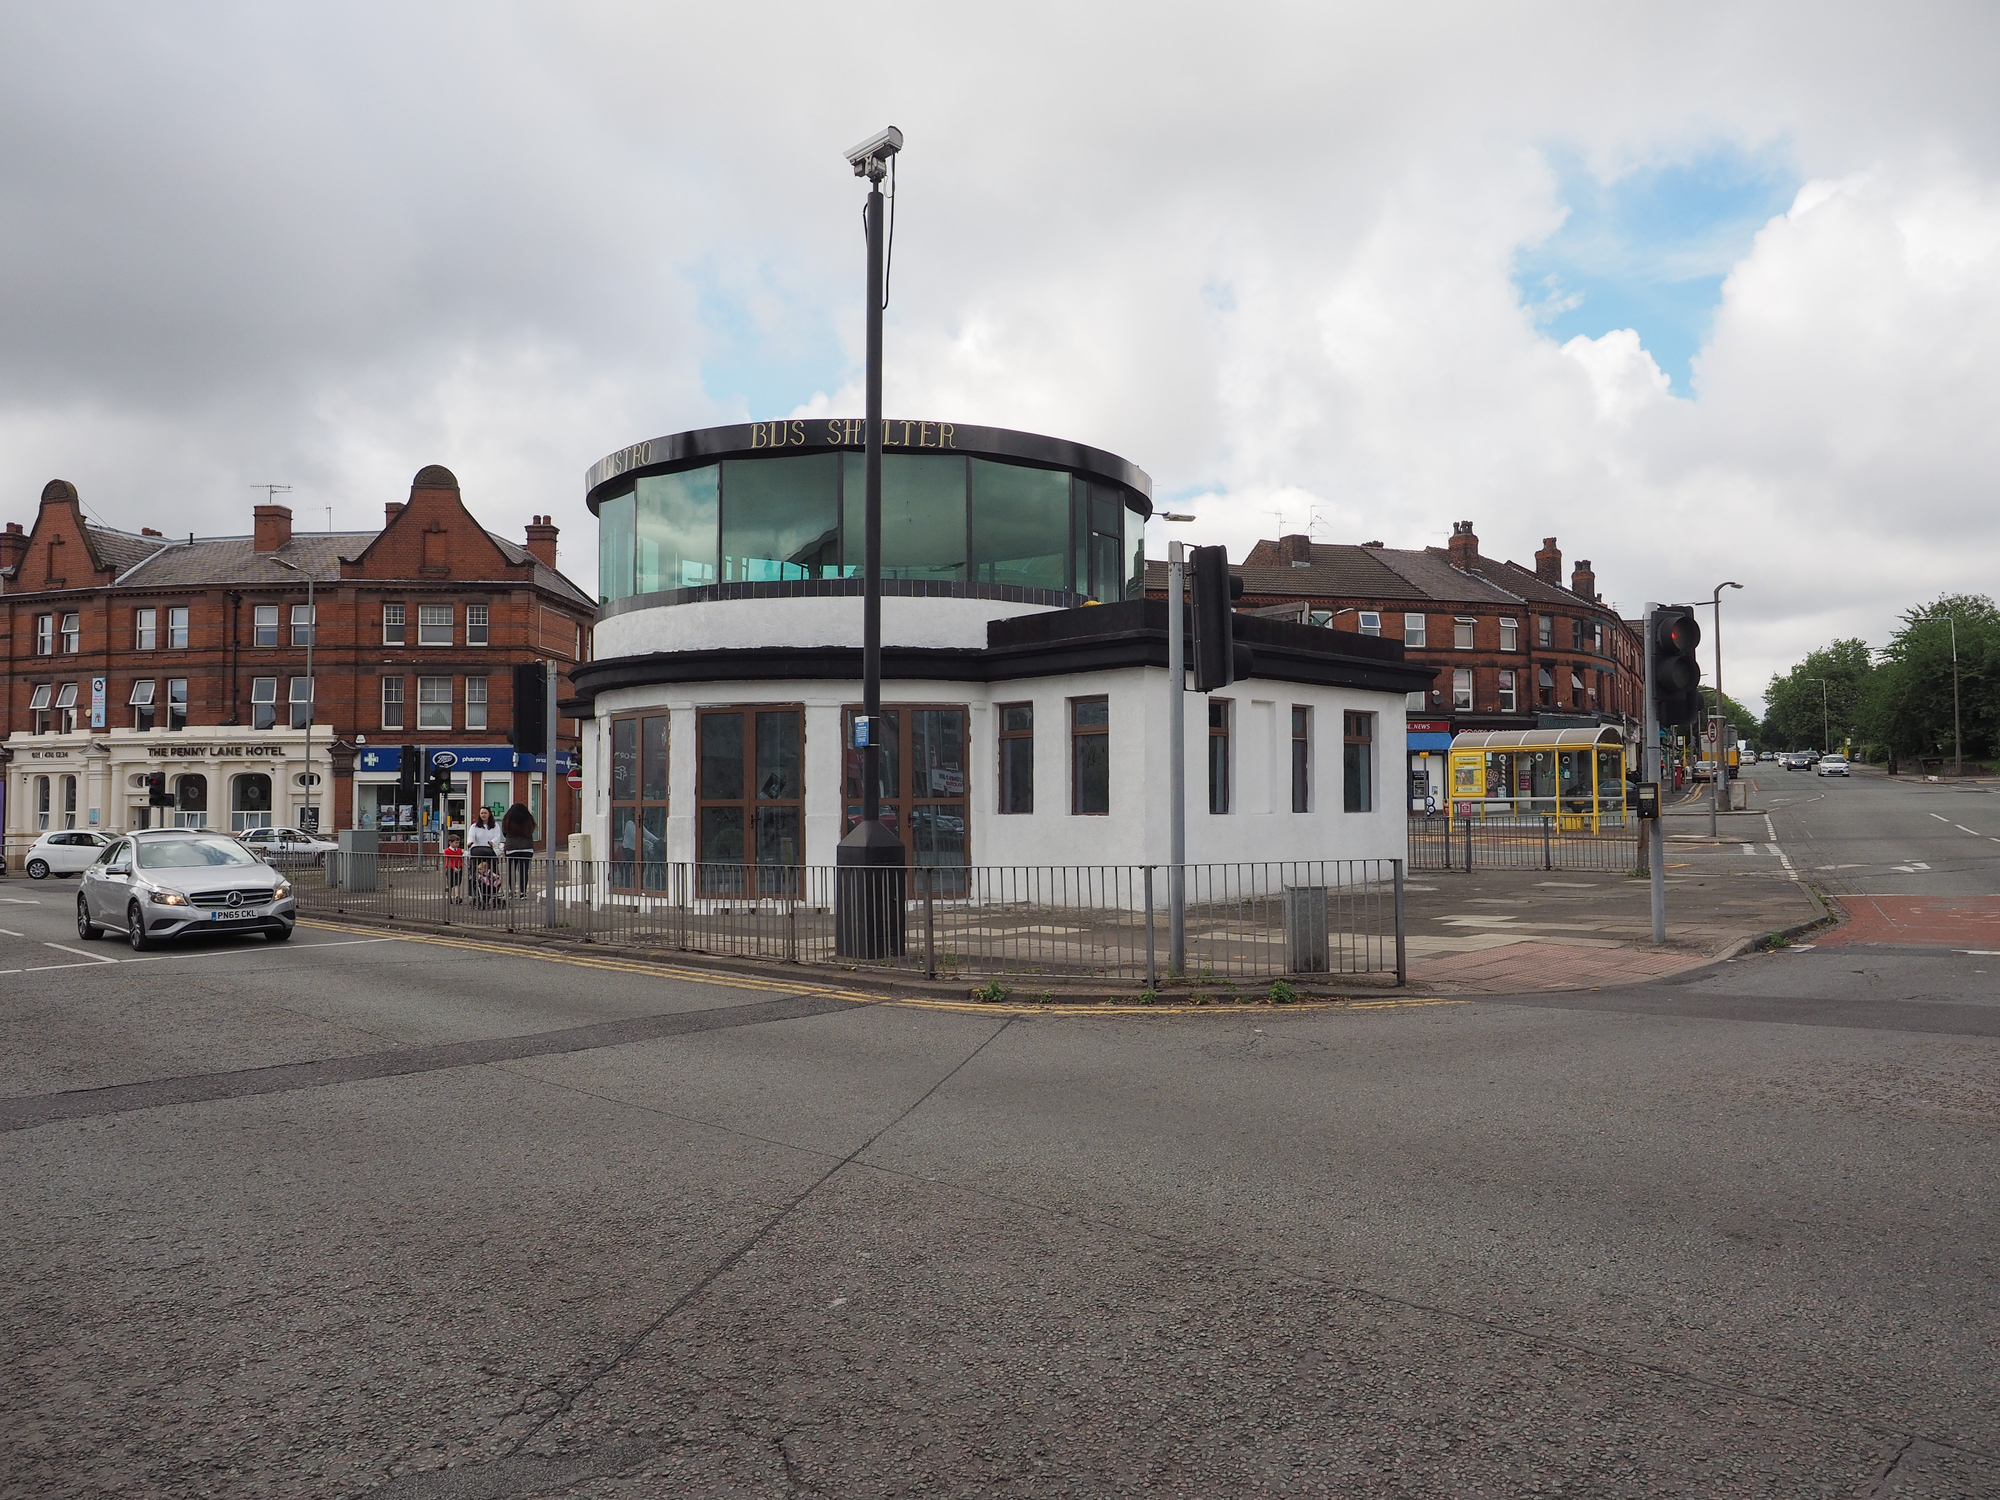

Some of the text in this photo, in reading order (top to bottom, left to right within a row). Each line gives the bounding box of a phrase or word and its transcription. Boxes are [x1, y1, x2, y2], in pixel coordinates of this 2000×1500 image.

[750, 419, 957, 448] BUS SHLTER
[602, 441, 652, 481] BISTRO
[147, 747, 286, 757] THE PENNY LANE HOTEL
[217, 910, 257, 919] PN65 CKL
